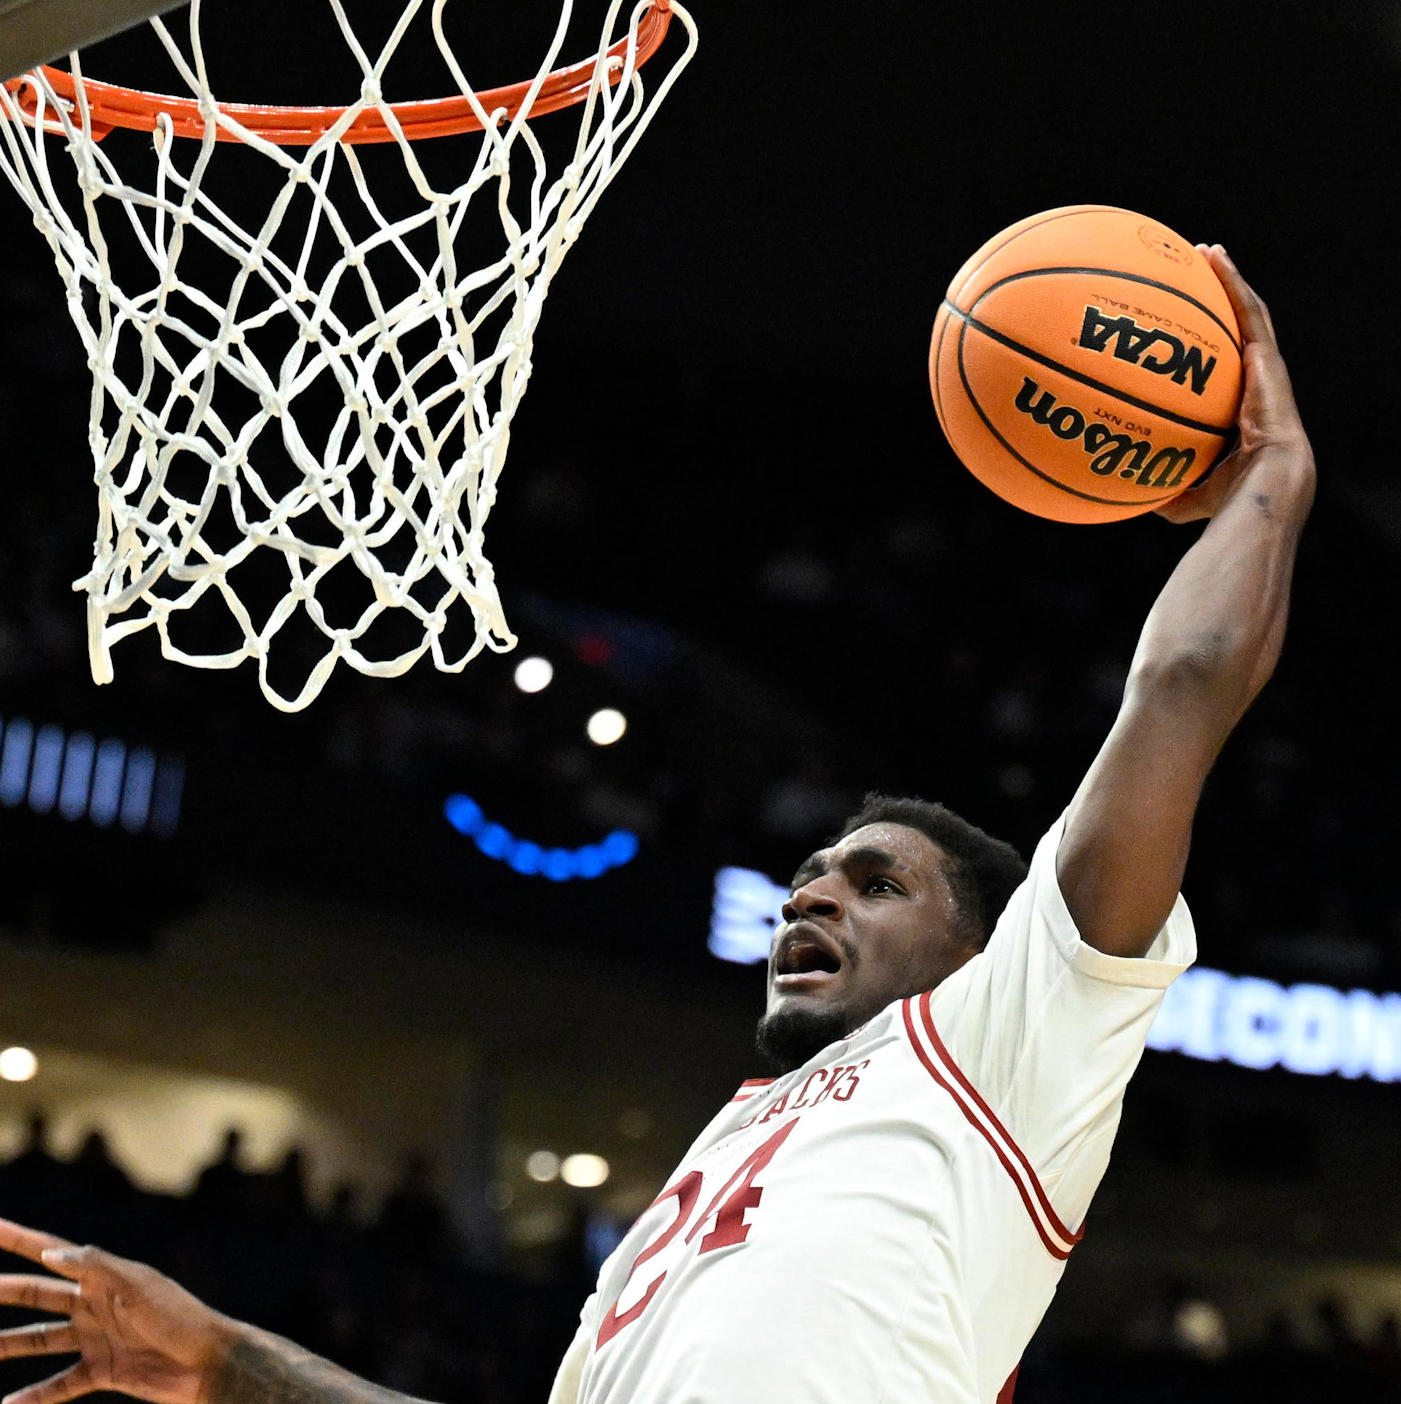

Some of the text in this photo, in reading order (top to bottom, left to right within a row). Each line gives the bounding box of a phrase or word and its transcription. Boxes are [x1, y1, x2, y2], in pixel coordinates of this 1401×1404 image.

[1090, 293, 1131, 312] BALL
[1078, 305, 1218, 396] NCAA
[1014, 376, 1197, 488] Wilson
[1094, 407, 1122, 425] NXT
[596, 1116, 801, 1353] 24
